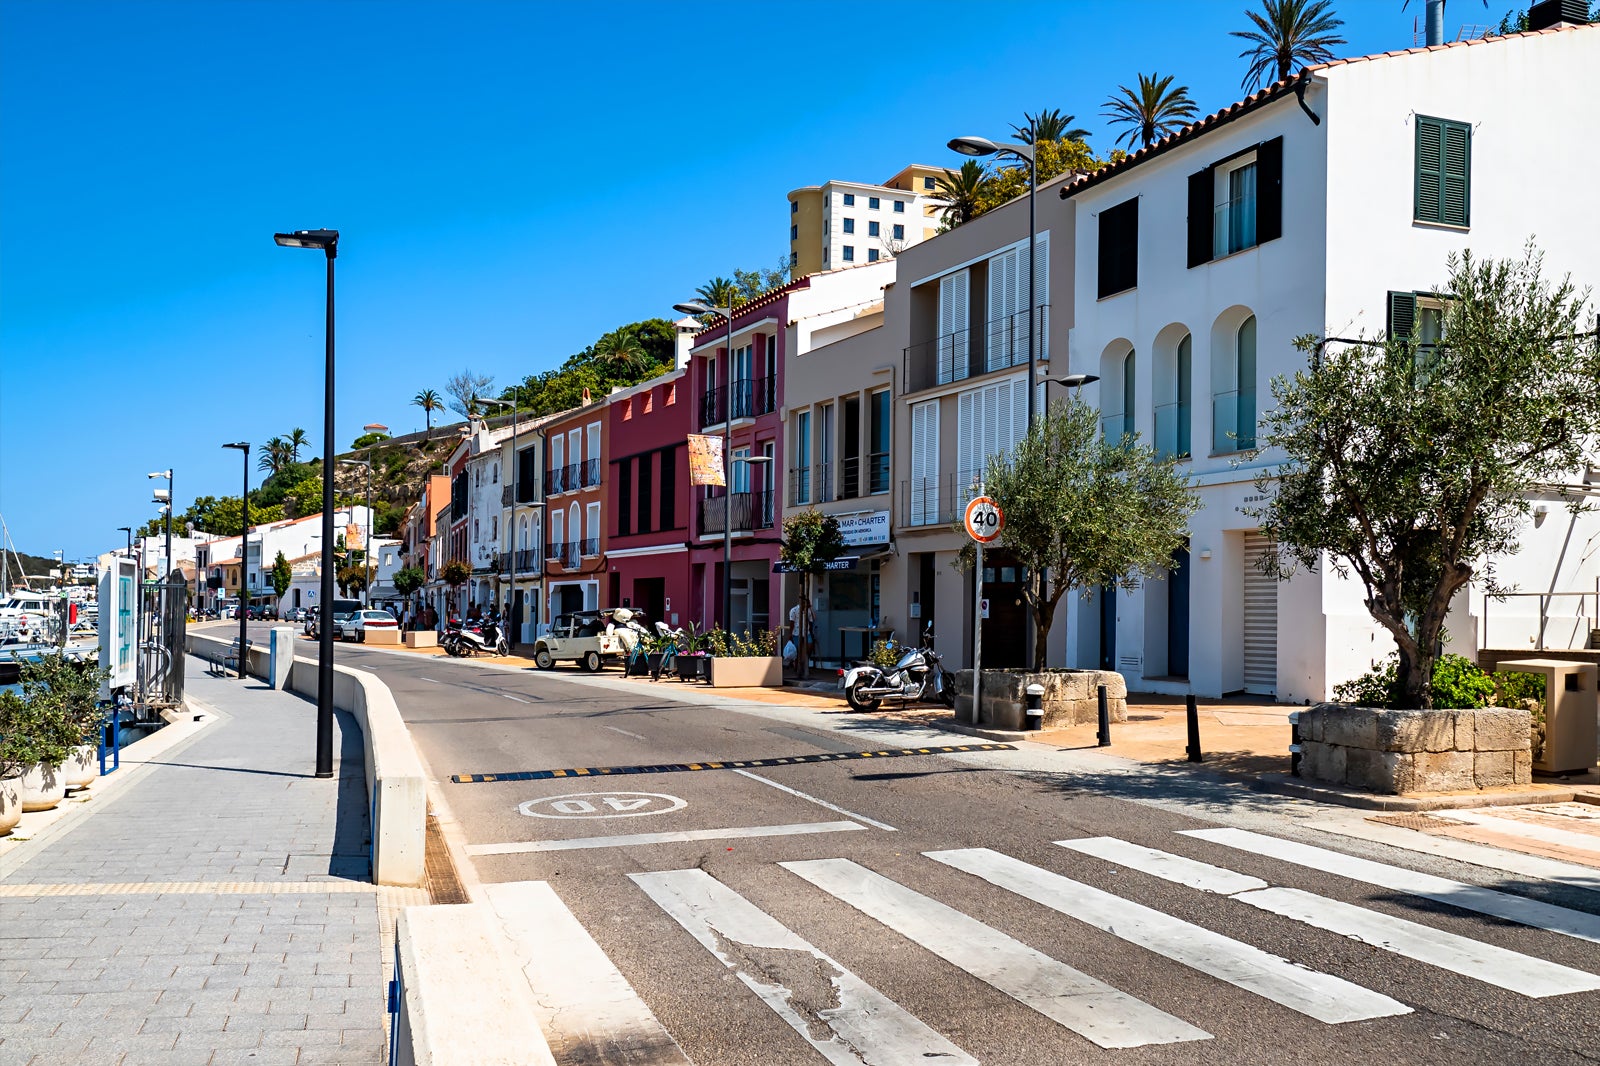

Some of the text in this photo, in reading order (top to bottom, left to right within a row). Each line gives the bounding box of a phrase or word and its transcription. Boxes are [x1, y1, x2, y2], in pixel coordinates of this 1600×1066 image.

[841, 519, 854, 528] MAR
[858, 515, 886, 526] CHARTER
[973, 511, 997, 527] 40
[824, 561, 849, 570] CHARTER
[551, 797, 652, 814] 40
